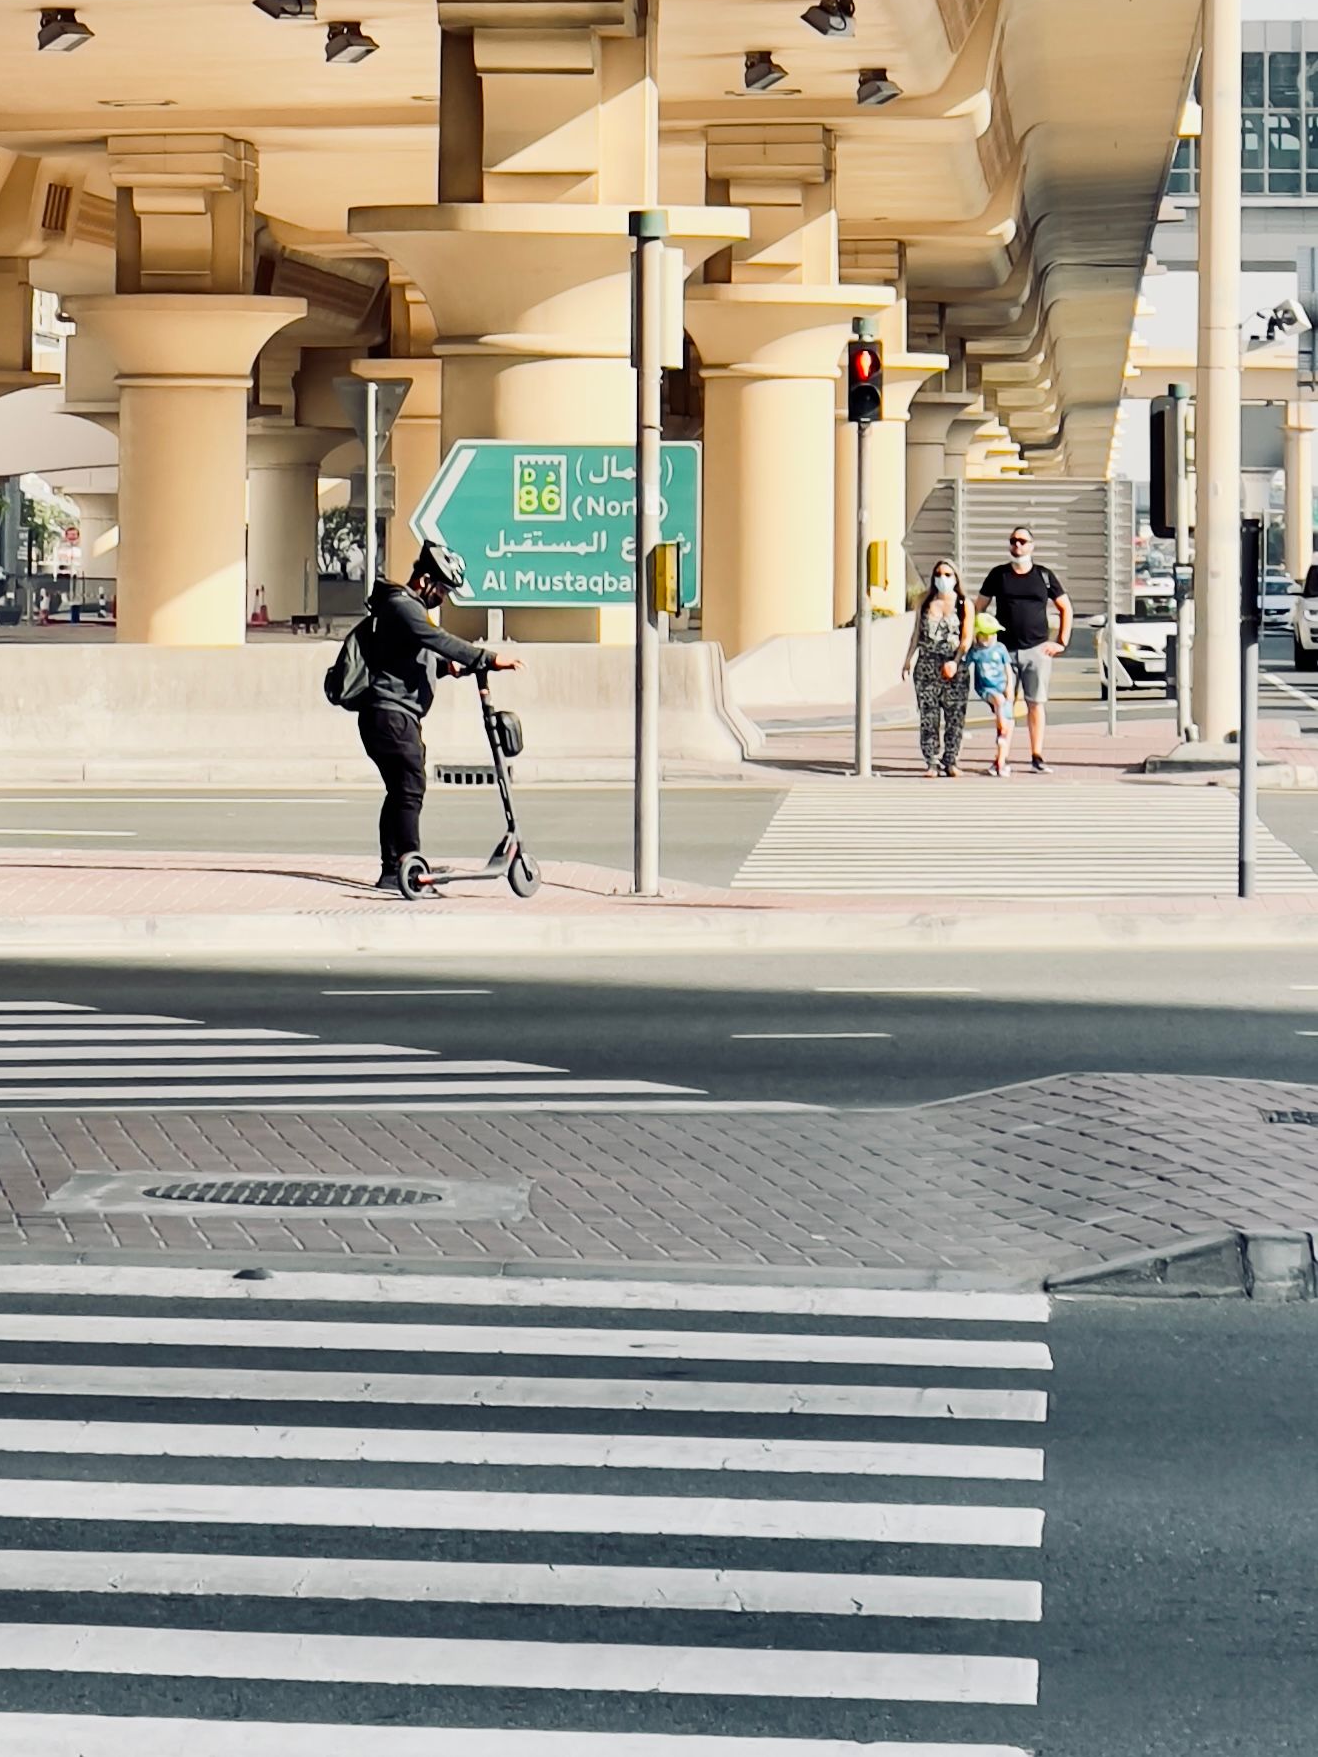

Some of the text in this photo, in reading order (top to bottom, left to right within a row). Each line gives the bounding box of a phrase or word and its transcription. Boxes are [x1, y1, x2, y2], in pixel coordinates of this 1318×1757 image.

[523, 467, 536, 483] D
[519, 484, 561, 512] 86
[485, 529, 607, 558] المستقبل
[482, 569, 507, 591] Al
